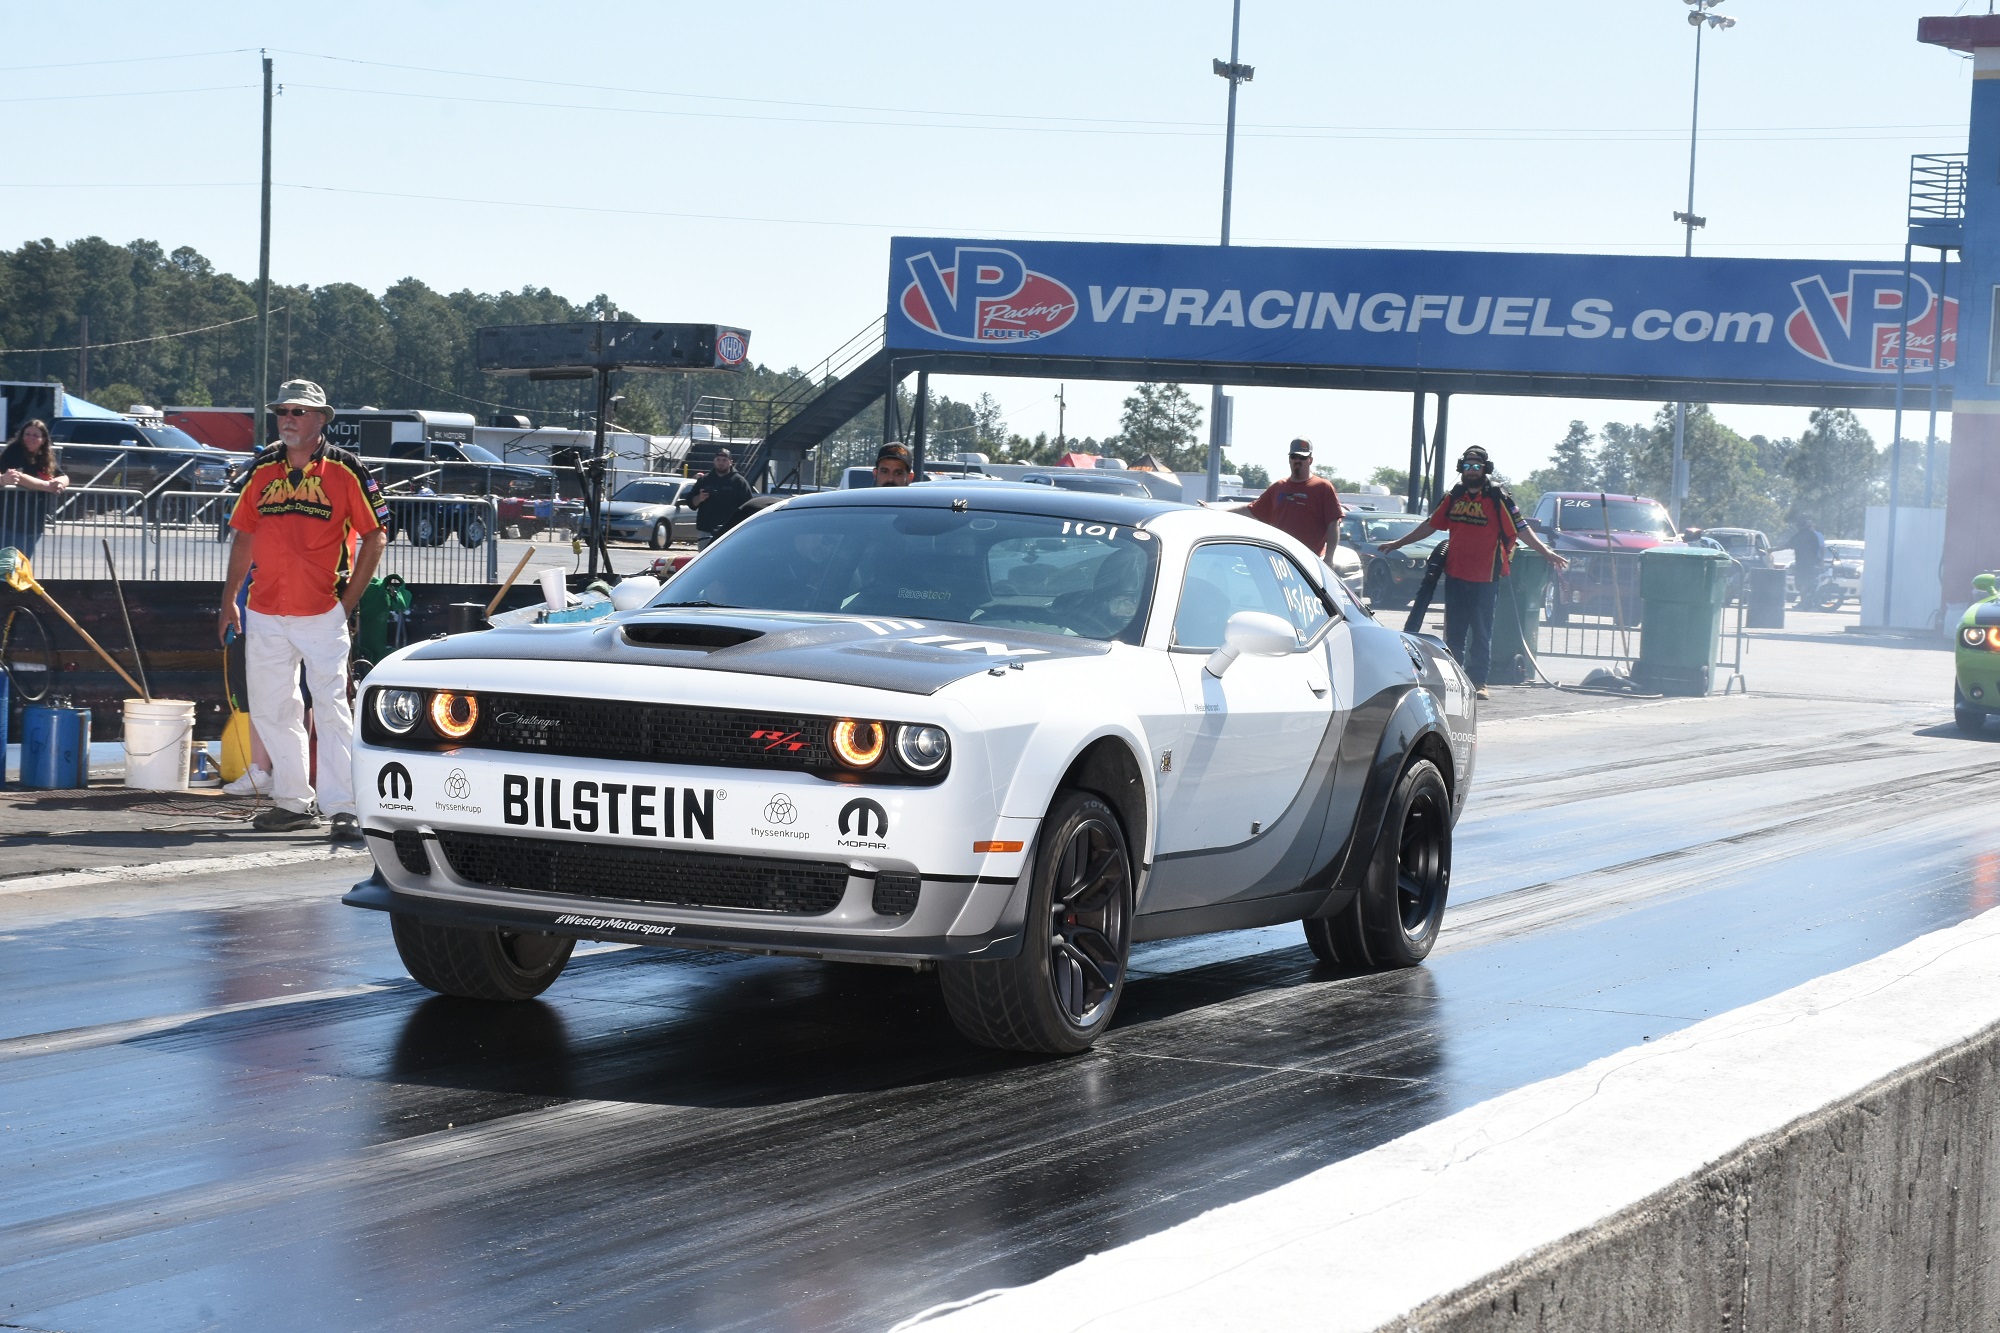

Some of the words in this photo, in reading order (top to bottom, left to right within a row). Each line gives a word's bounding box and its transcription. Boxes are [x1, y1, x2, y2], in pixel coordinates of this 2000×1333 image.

[905, 247, 1026, 339] VP
[983, 301, 1075, 327] Racing
[1088, 284, 1774, 343] VPRACINGFUELS.com
[1790, 269, 1932, 370] VP
[982, 328, 1041, 340] FUELS
[720, 336, 743, 360] NHRA
[444, 432, 467, 440] MOTORS
[295, 502, 331, 518] Dragway
[1564, 499, 1591, 508] 216
[1061, 521, 1119, 540] 1101
[898, 587, 951, 601] Racetech
[495, 711, 561, 730] Challenger
[750, 729, 811, 751] R/T
[1451, 731, 1477, 744] DODGE
[379, 802, 414, 812] MOPAR
[435, 801, 482, 814] thyssenkrupp
[503, 773, 714, 841] BILSTEIN
[1083, 800, 1111, 815] TOYO
[750, 827, 811, 840] thyssenkrupp
[837, 839, 887, 850] MOPAR
[554, 914, 676, 936] #WesleyMotorsport
